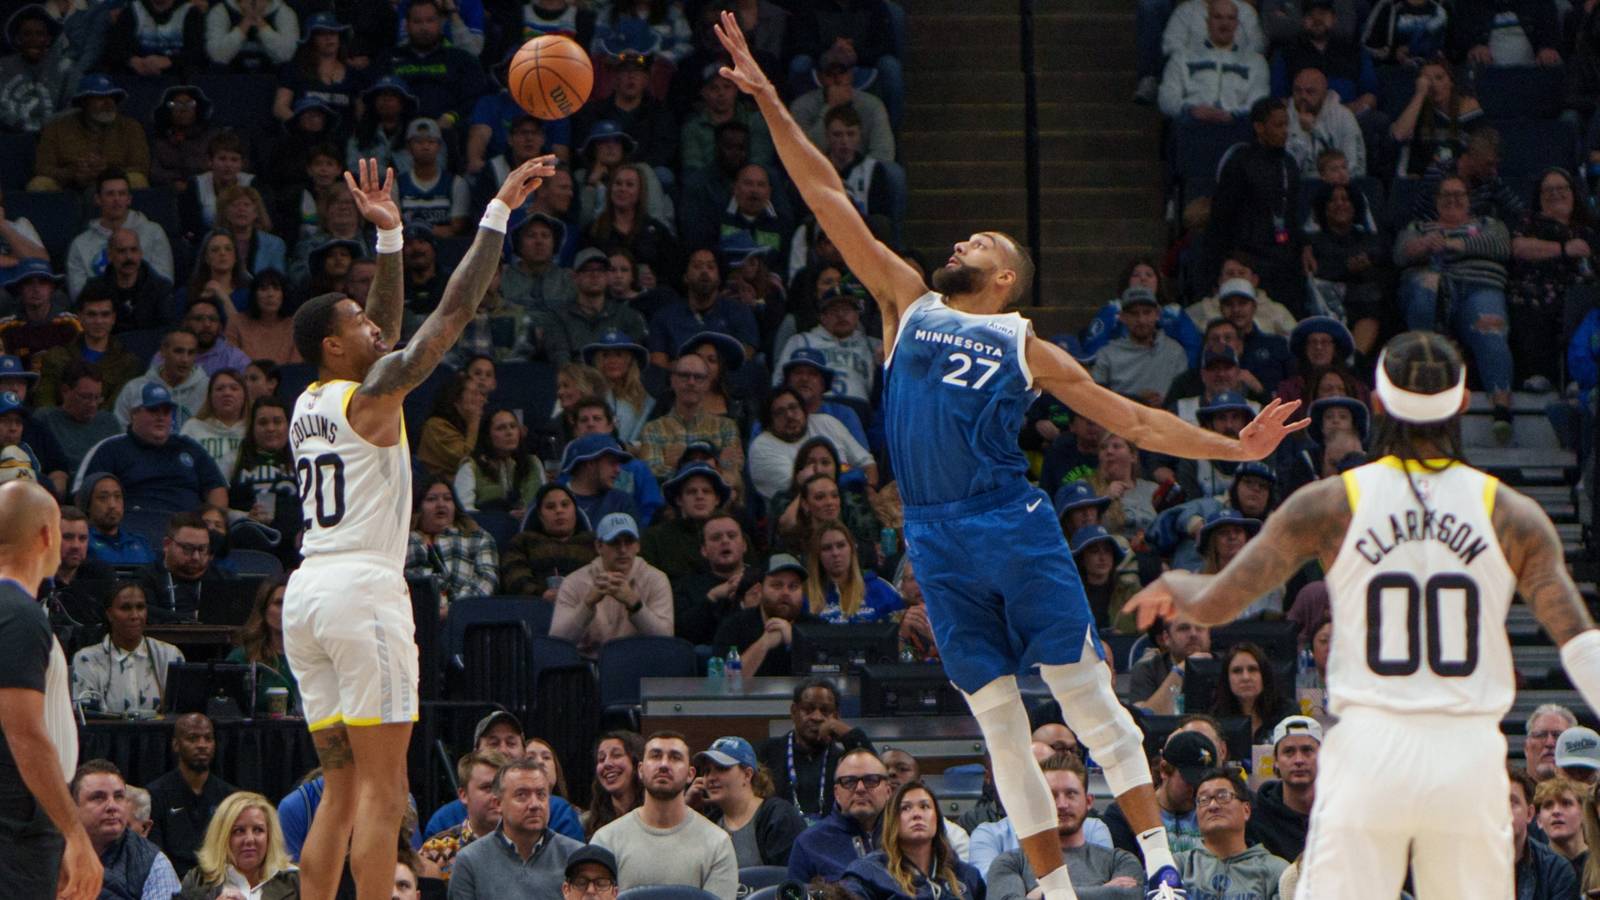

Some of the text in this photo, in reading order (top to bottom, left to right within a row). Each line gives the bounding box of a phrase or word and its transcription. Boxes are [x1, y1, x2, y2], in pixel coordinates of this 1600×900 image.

[915, 329, 1003, 358] MINNESOTA
[988, 322, 1015, 337] AURA
[942, 352, 1001, 389] 27
[291, 414, 338, 449] COLLINS
[297, 453, 345, 528] 20
[1355, 509, 1489, 566] CLARKSON
[1367, 572, 1479, 676] 00
